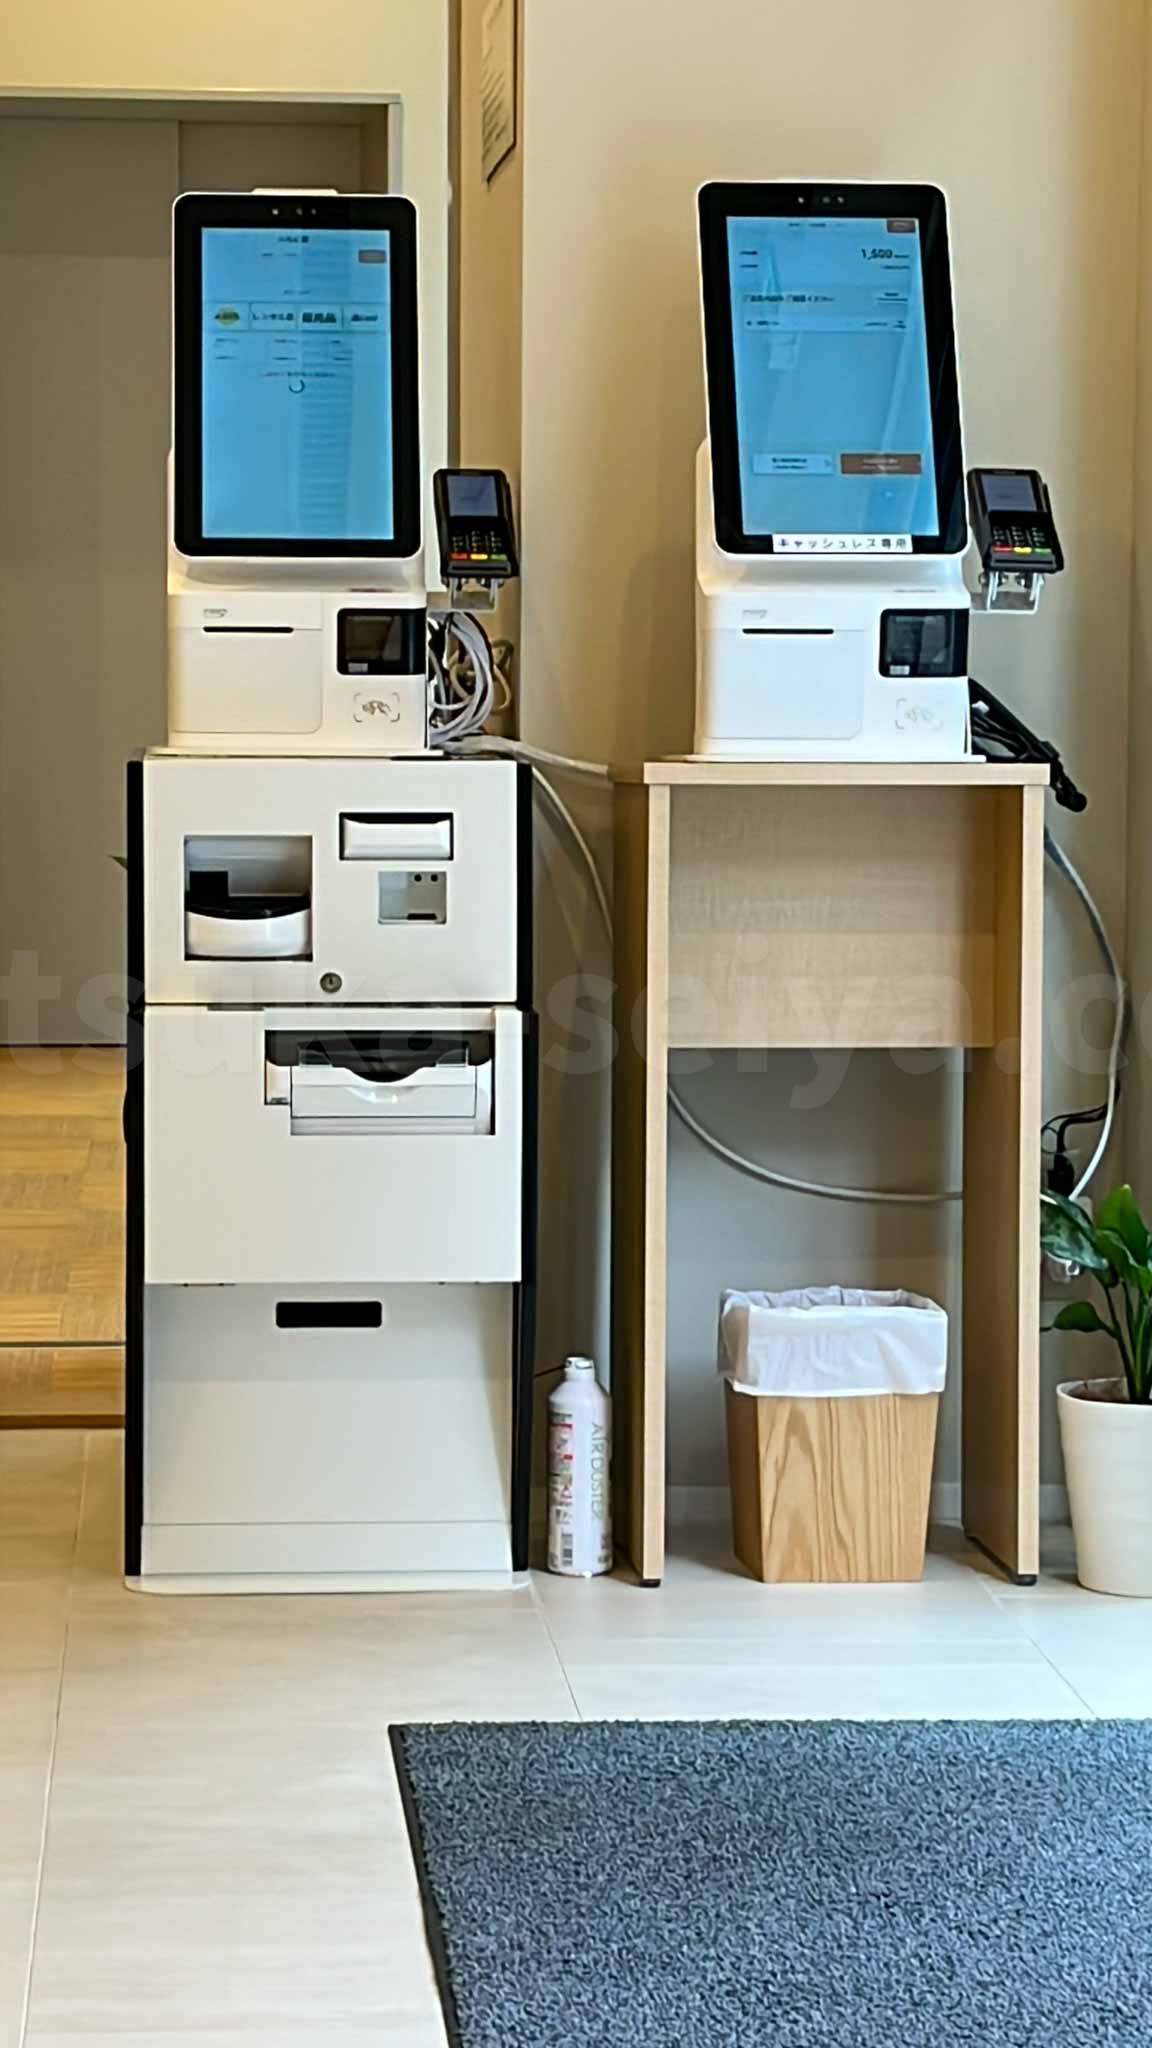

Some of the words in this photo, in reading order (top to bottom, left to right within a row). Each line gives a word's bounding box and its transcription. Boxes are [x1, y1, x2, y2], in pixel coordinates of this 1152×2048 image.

[777, 537, 907, 550] キャッシュレス専用
[591, 1422, 609, 1454] AIR
